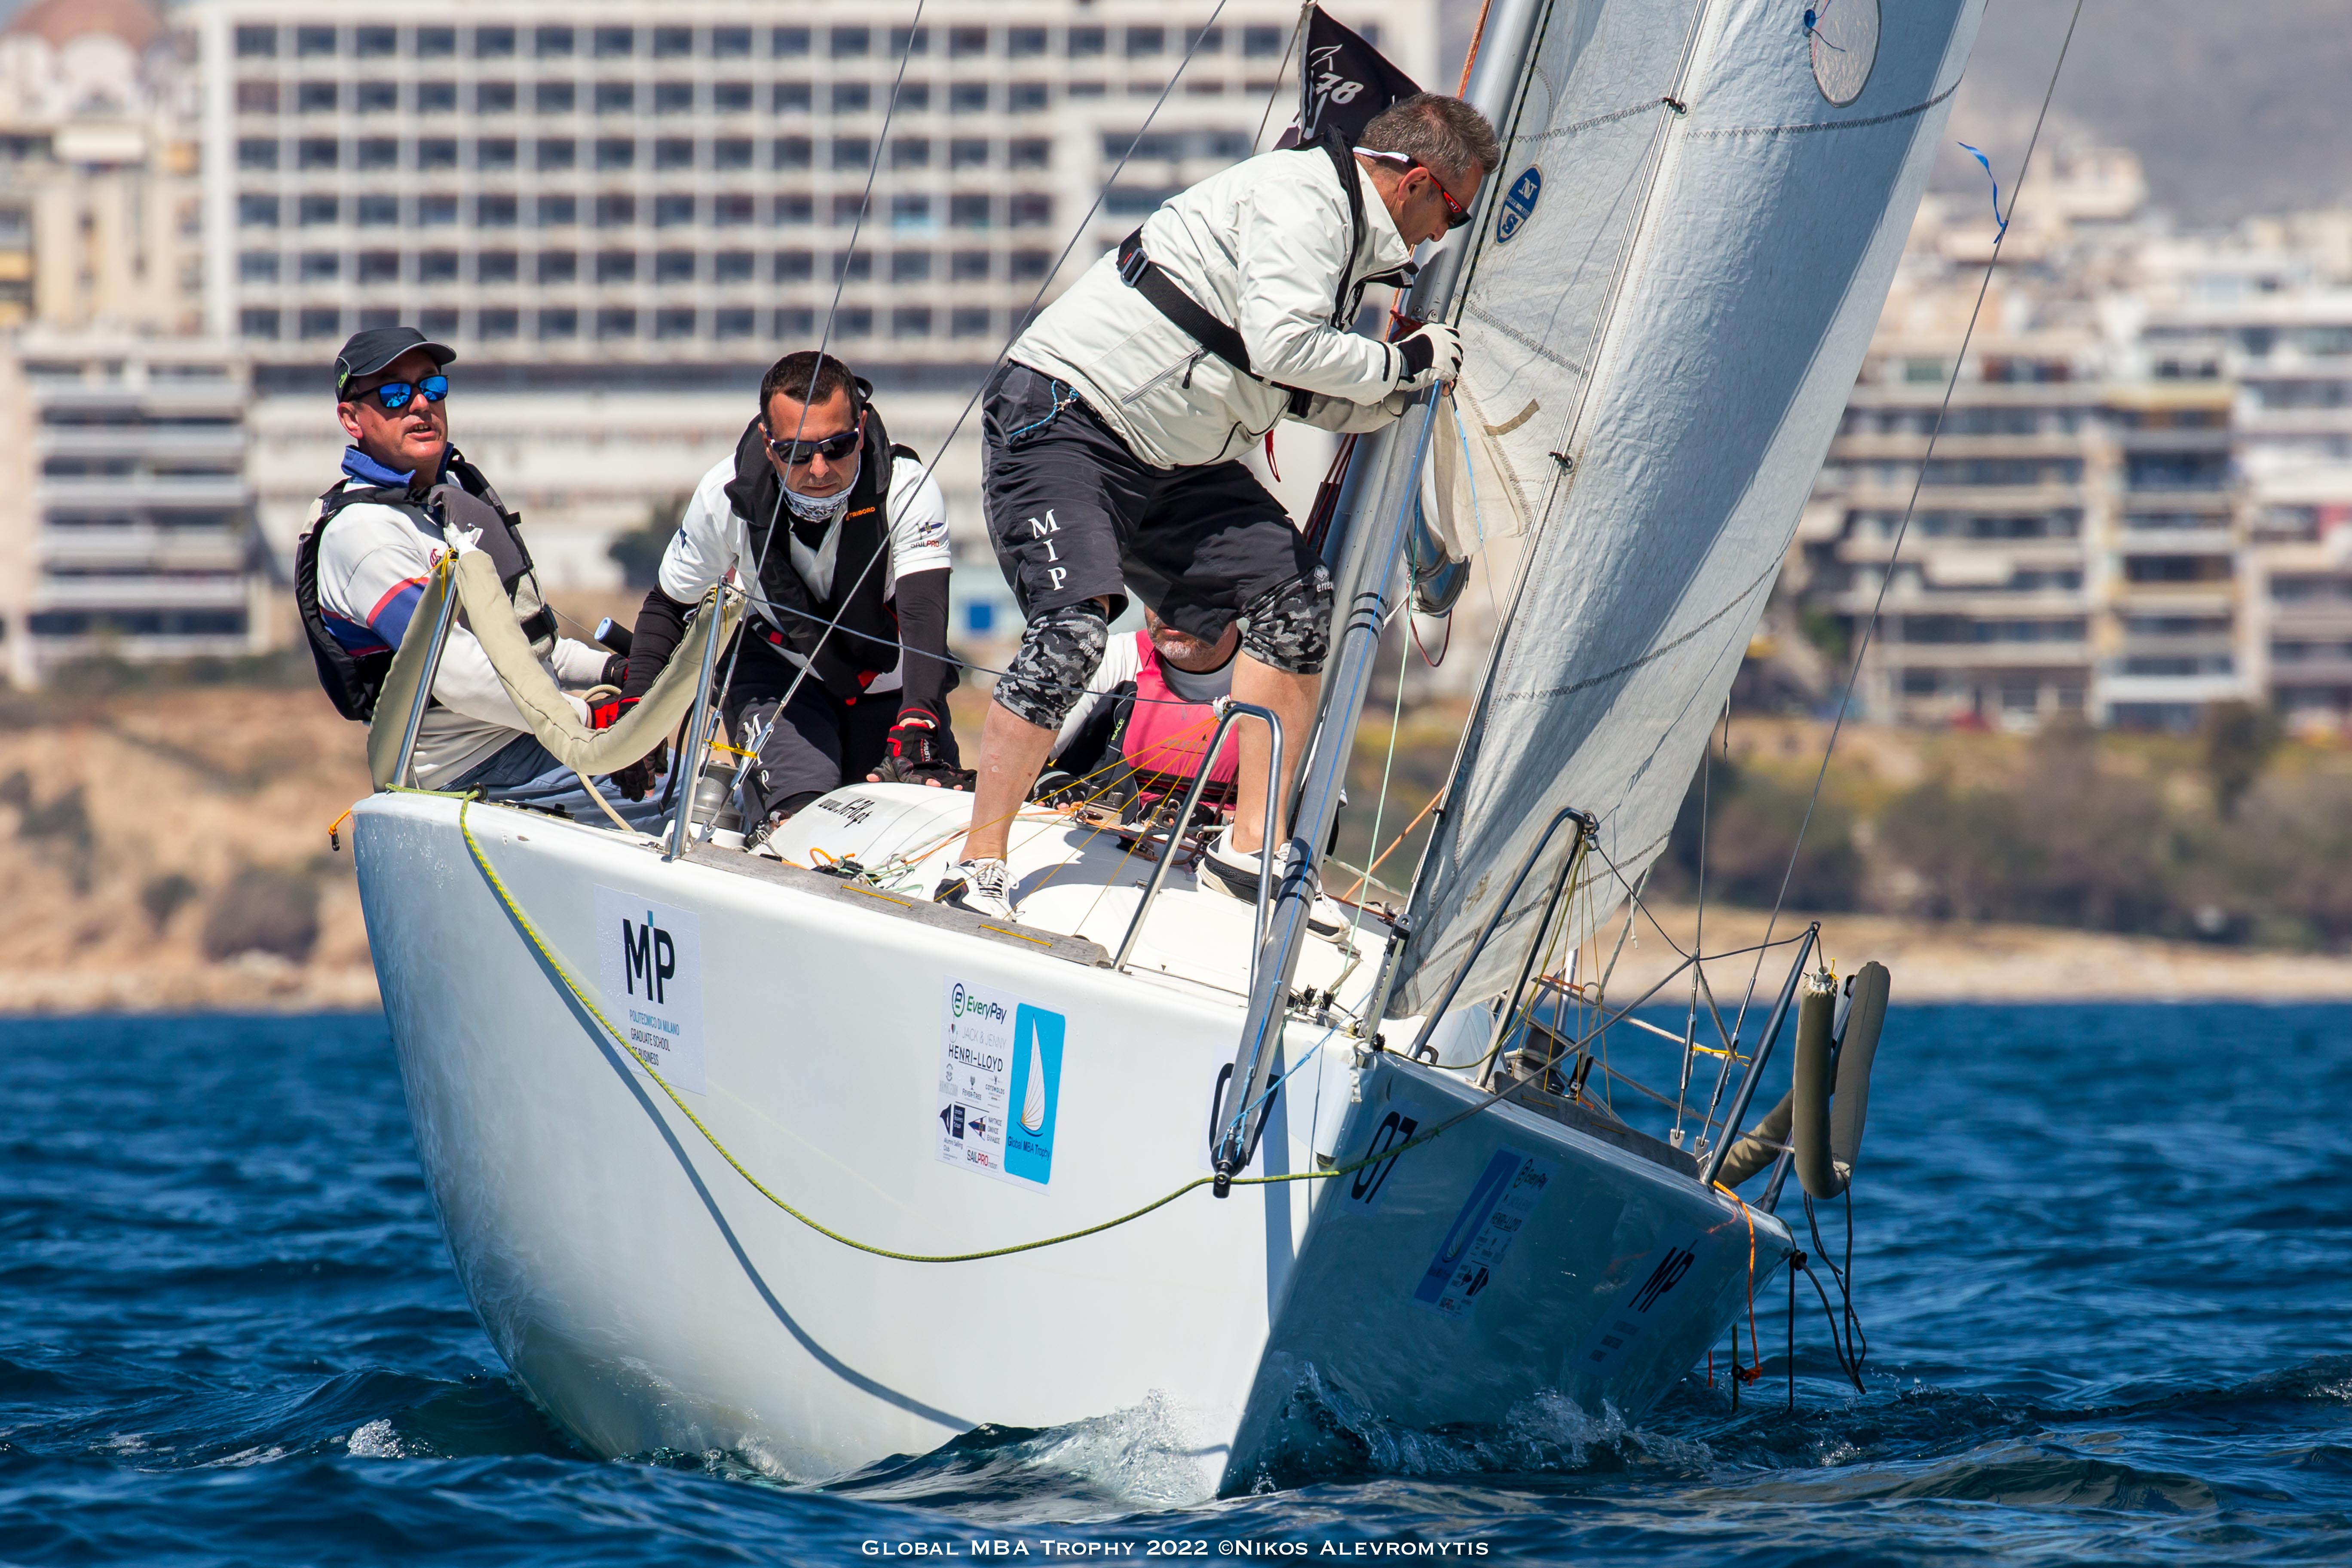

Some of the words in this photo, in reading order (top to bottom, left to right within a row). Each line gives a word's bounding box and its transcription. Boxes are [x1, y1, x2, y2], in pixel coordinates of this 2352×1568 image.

[1518, 178, 1537, 199] N
[1502, 213, 1519, 234] S
[849, 507, 875, 518] TRIBORD
[1028, 508, 1067, 591] MIP
[1111, 718, 1125, 740] RACE
[967, 995, 1007, 1024] EveryPay
[629, 1009, 657, 1029] POLITECNICO
[658, 1018, 662, 1030] DI
[663, 1020, 680, 1036] MILANO
[631, 1028, 652, 1046] GRADUATE
[653, 1035, 671, 1051] SCHOOL
[962, 1027, 979, 1041] JACK
[980, 1031, 984, 1044] &
[985, 1034, 1007, 1050] JENNY
[948, 1044, 1003, 1072] HENRI-LLOYD
[986, 1084, 1005, 1095] COTSWOLDS
[954, 1139, 963, 1150] Sailing
[1008, 1136, 1023, 1149] Global
[1023, 1141, 1034, 1154] MBA
[1035, 1144, 1050, 1161] Trophy
[1351, 1111, 1418, 1204] 07
